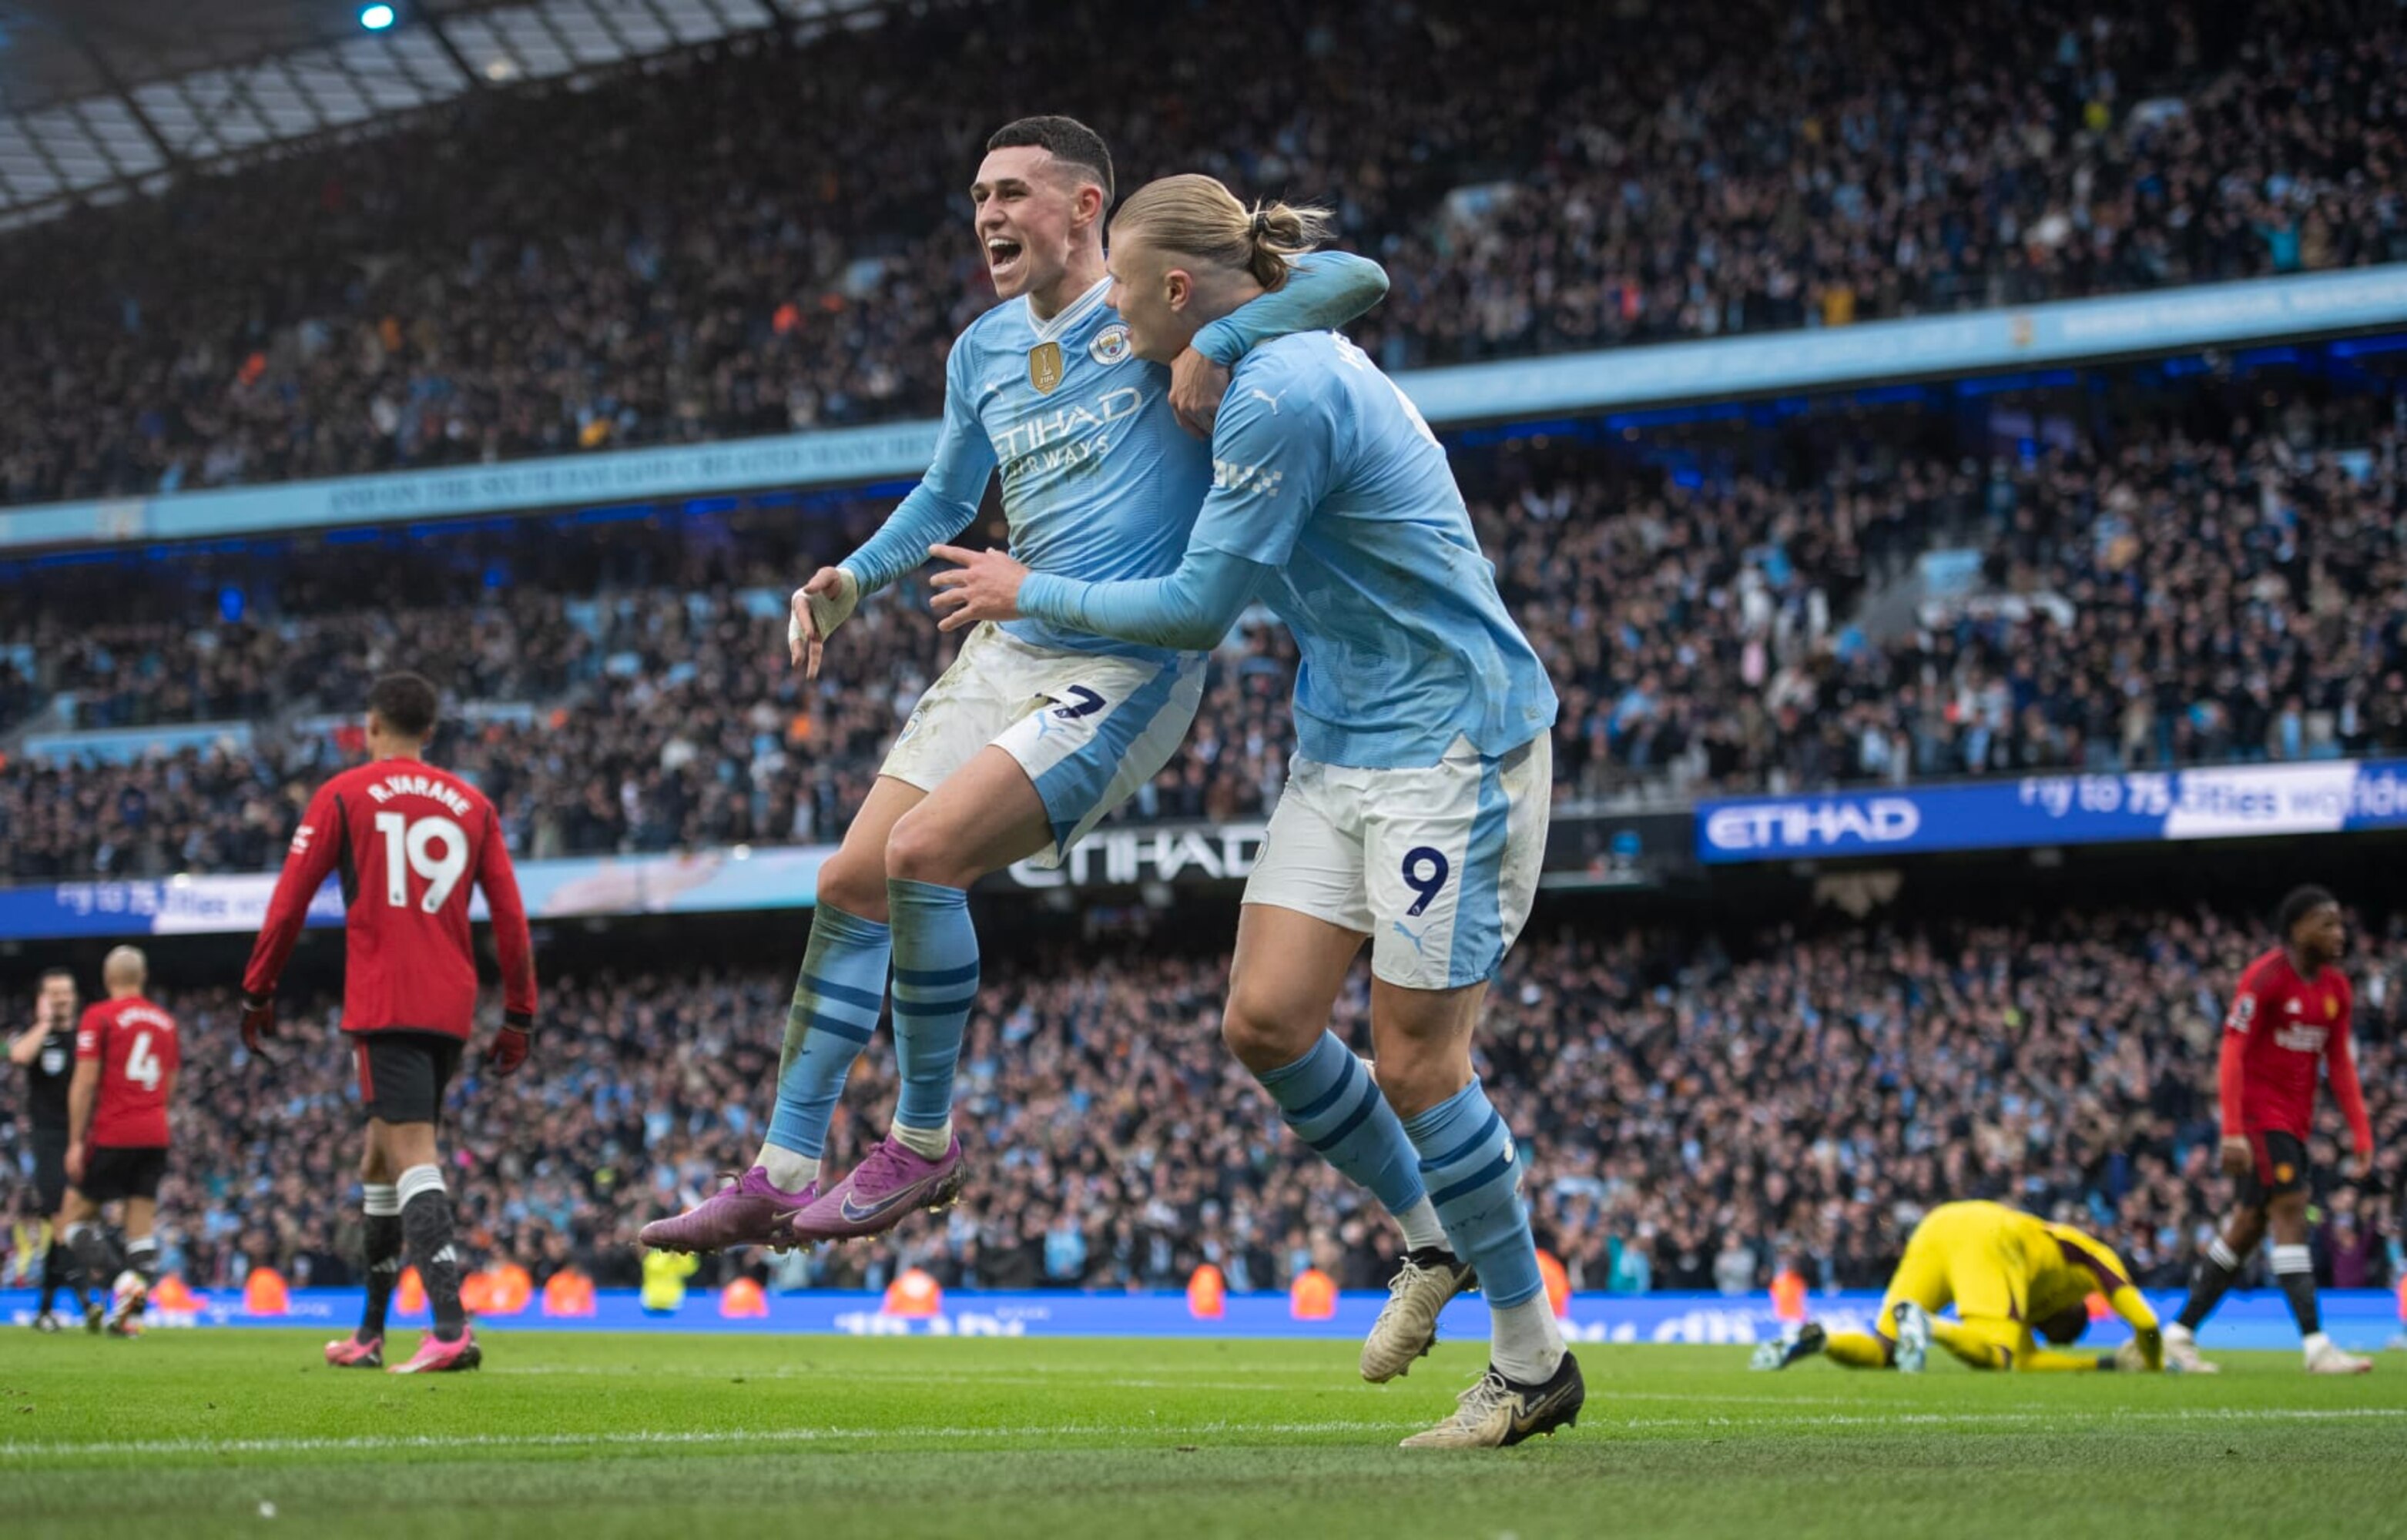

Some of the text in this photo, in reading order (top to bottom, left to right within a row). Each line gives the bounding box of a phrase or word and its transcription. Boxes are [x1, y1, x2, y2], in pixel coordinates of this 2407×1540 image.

[1040, 374, 1055, 384] FIFA
[367, 774, 471, 817] R.VARANE
[1705, 798, 1919, 849] ETIHAD
[374, 810, 469, 916] 19
[1402, 846, 1448, 916] 9
[126, 1031, 159, 1091] 4
